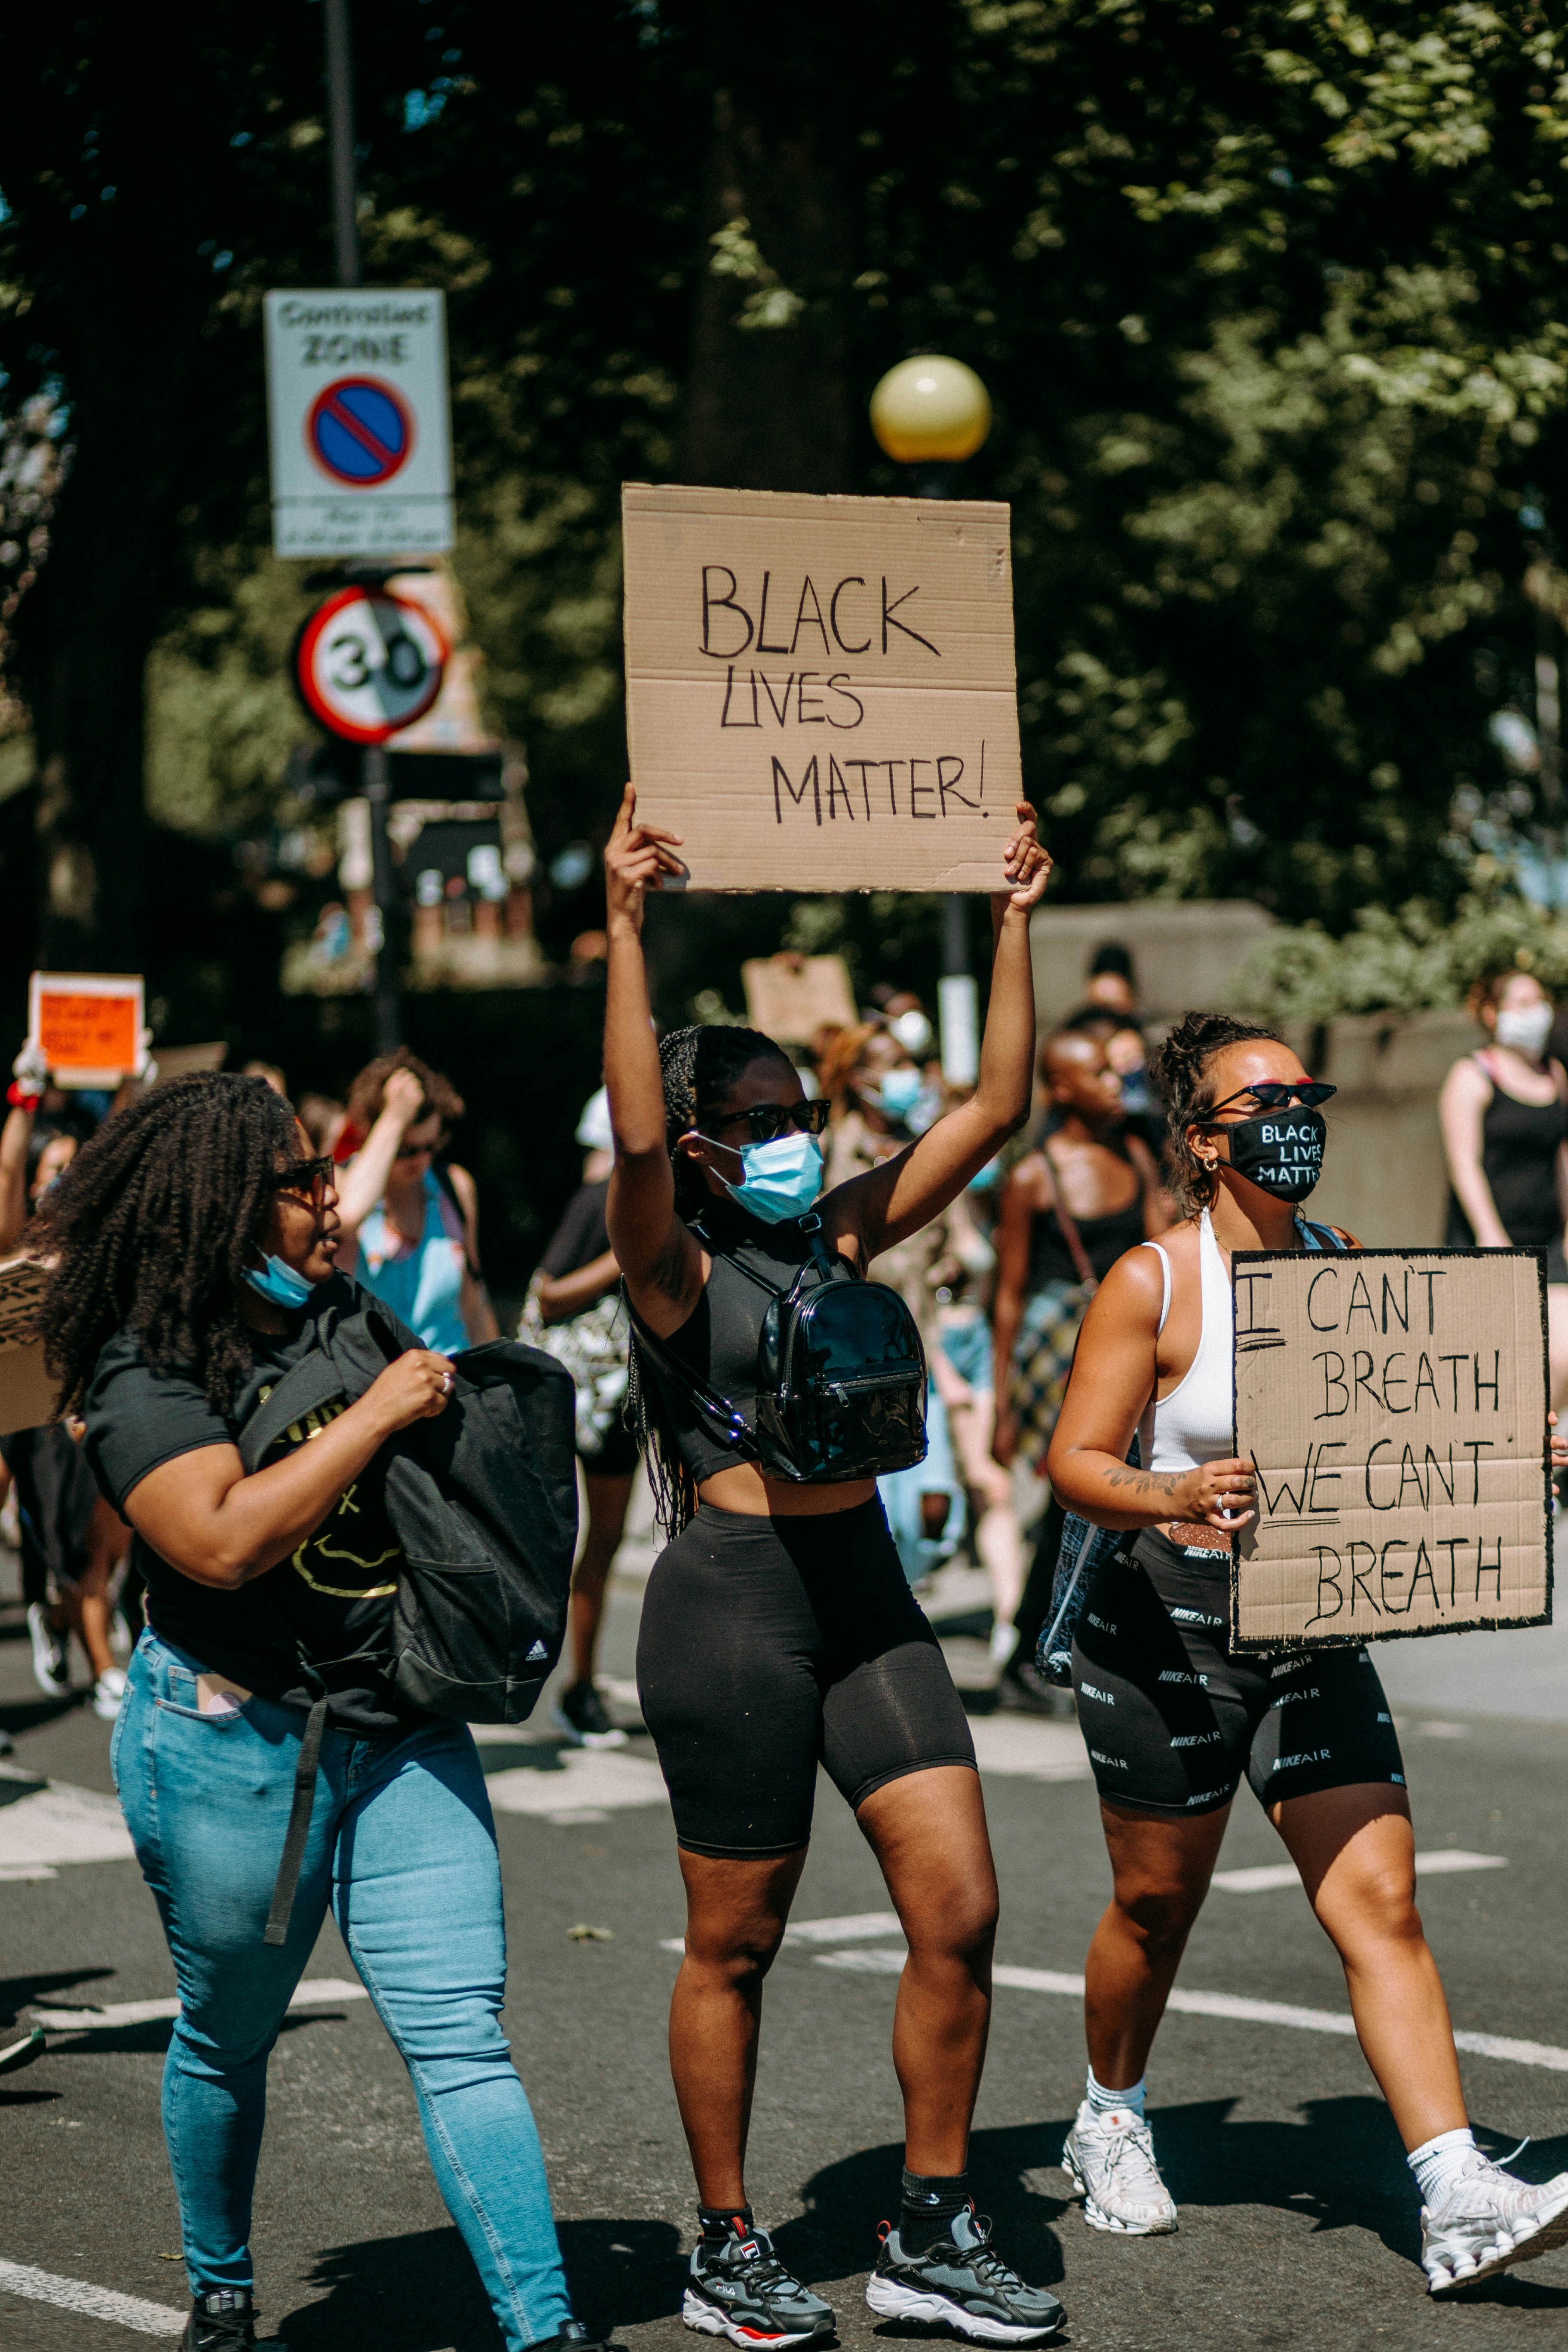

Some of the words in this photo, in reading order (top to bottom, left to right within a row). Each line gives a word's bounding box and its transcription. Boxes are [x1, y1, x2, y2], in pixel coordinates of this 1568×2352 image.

[303, 334, 407, 365] ZONE
[698, 565, 941, 658] BLACK
[330, 634, 423, 690] 30
[720, 665, 864, 729] LIVES
[771, 739, 989, 826] MATTER!
[1262, 1124, 1318, 1143] BLACK
[1257, 1166, 1319, 1184] MATTE
[1236, 1273, 1280, 1334] I
[1307, 1265, 1447, 1335] CAN'T
[1312, 1349, 1499, 1420] BREATH
[1250, 1442, 1347, 1517] WE
[1304, 1535, 1501, 1629] BREATH
[525, 1652, 548, 1661] adidas
